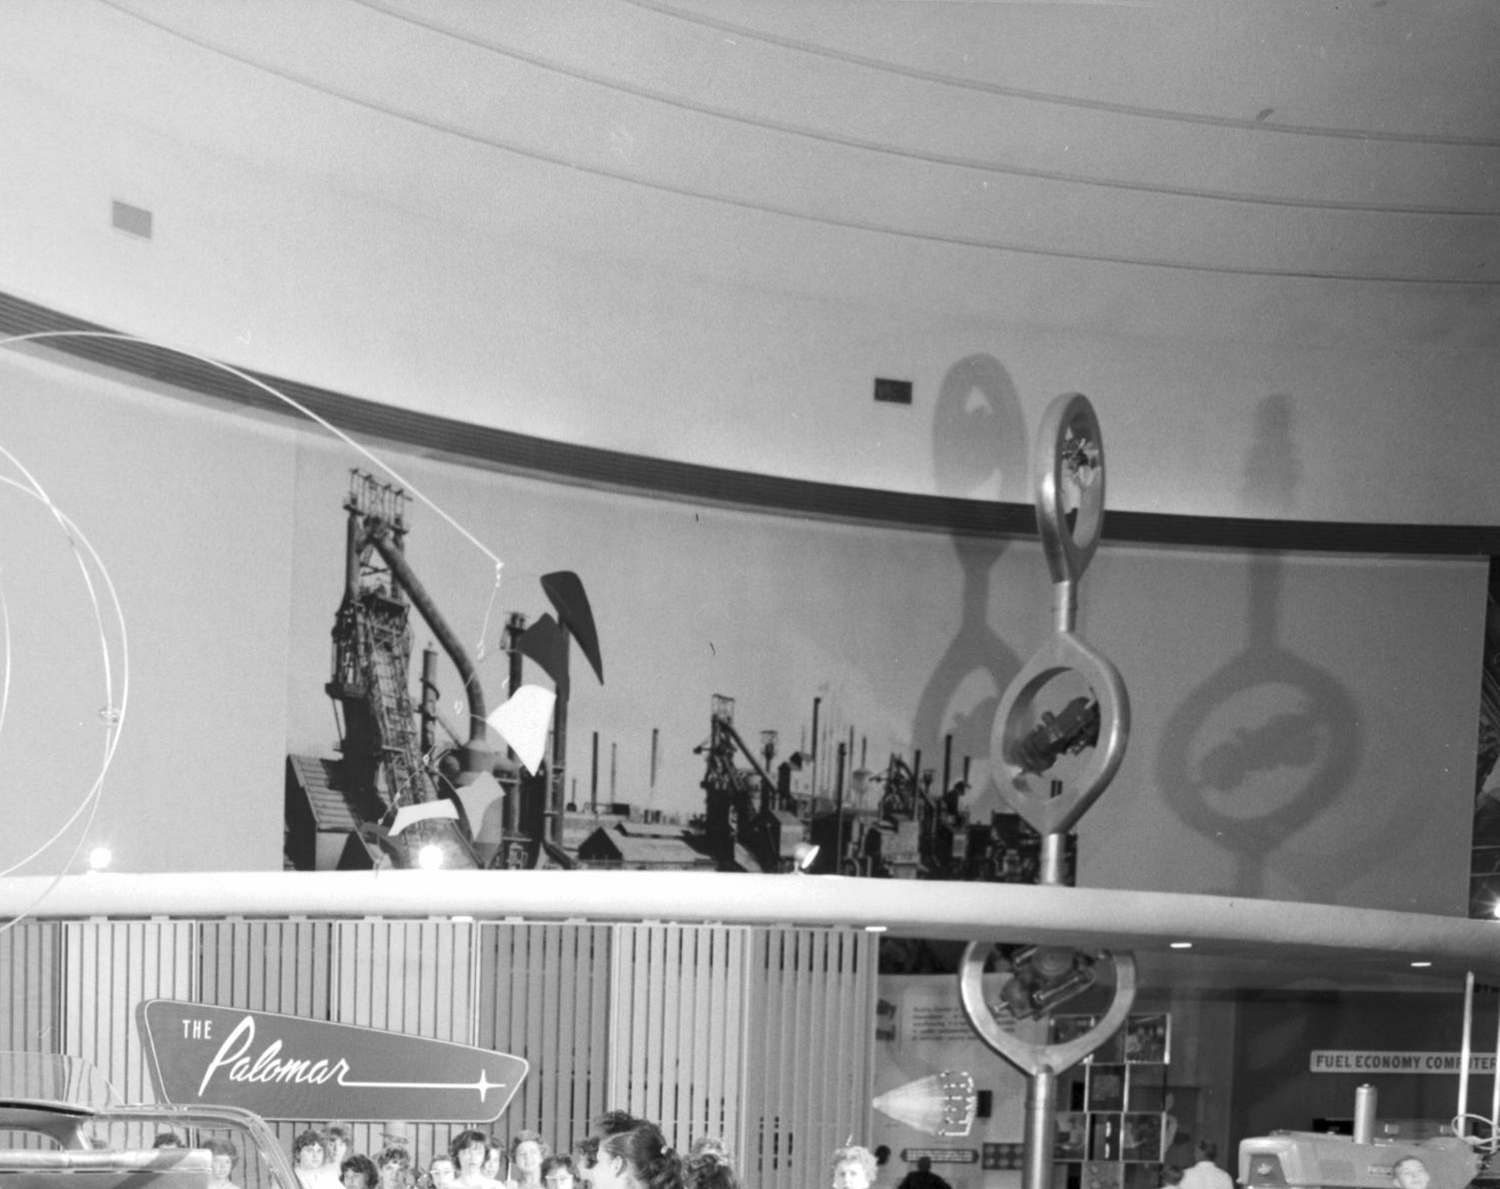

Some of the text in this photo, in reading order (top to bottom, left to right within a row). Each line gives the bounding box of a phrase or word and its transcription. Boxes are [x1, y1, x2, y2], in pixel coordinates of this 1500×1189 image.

[182, 1019, 213, 1039] THE
[198, 1015, 350, 1097] Palomar
[1315, 1054, 1352, 1068] FUEL
[1355, 1055, 1421, 1069] ECONOMY
